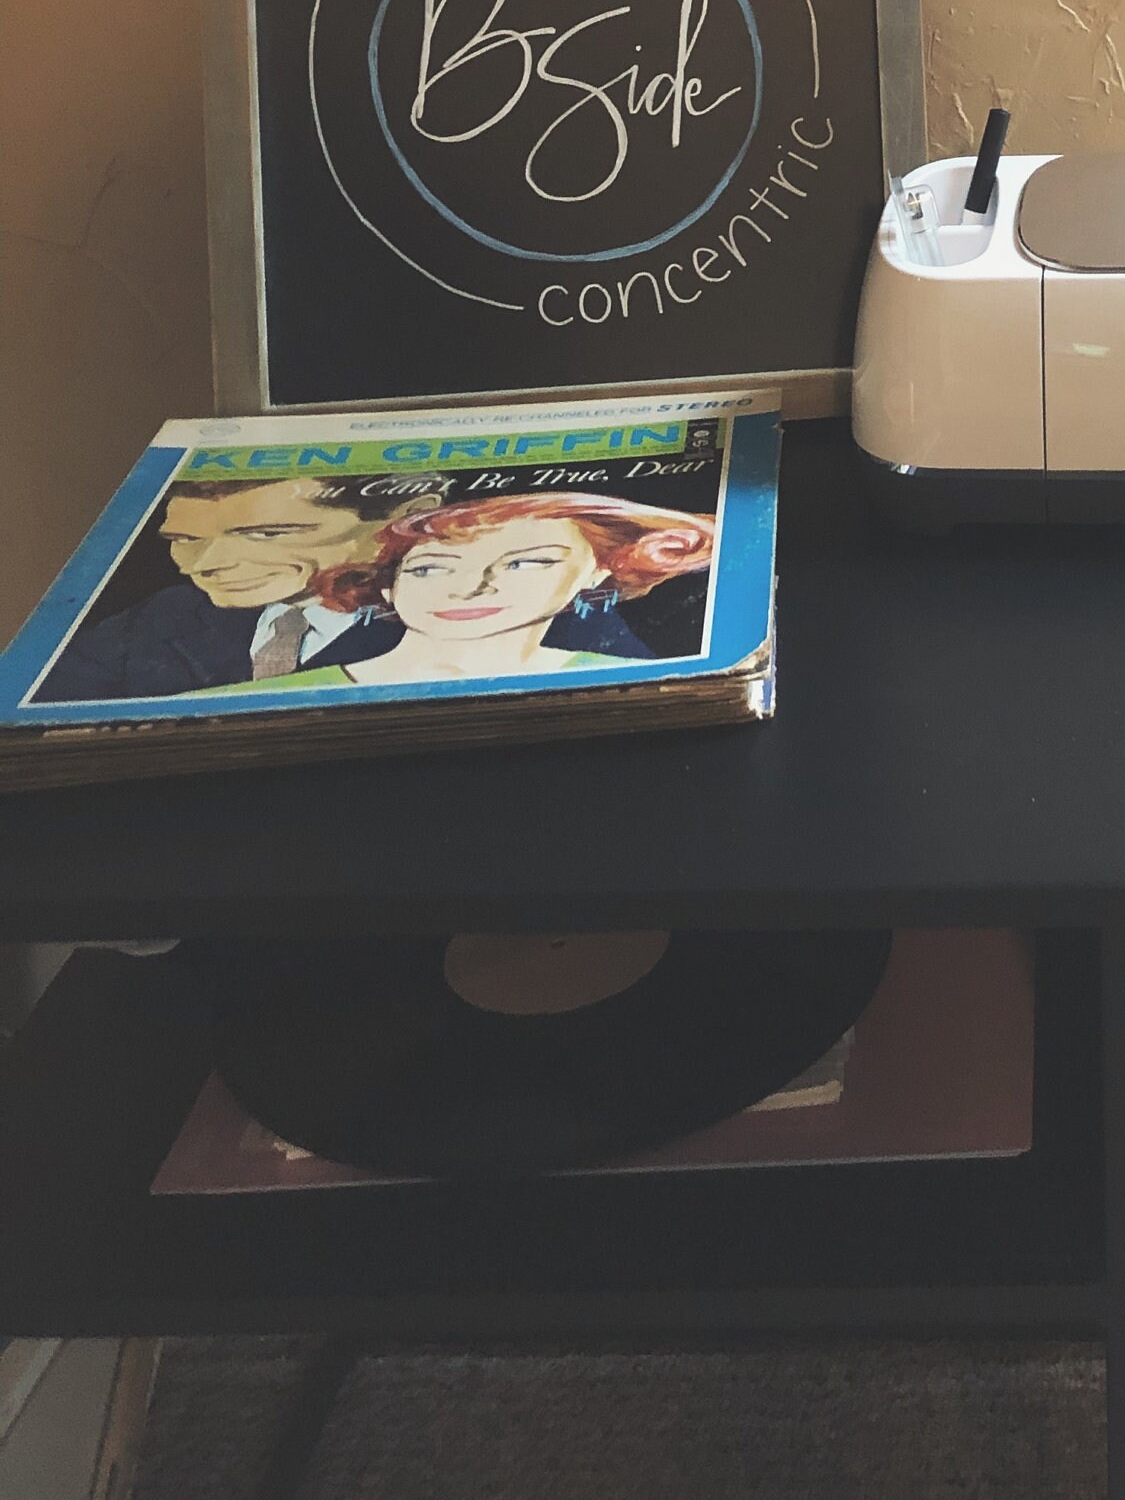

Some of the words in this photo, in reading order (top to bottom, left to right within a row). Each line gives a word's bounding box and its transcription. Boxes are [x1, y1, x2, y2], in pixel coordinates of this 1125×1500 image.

[536, 115, 834, 327] concentric
[656, 398, 753, 412] STEREO
[189, 446, 353, 470] KEN
[382, 426, 681, 463] GRIFFIN
[467, 473, 516, 491] Be
[623, 458, 714, 479] Dear
